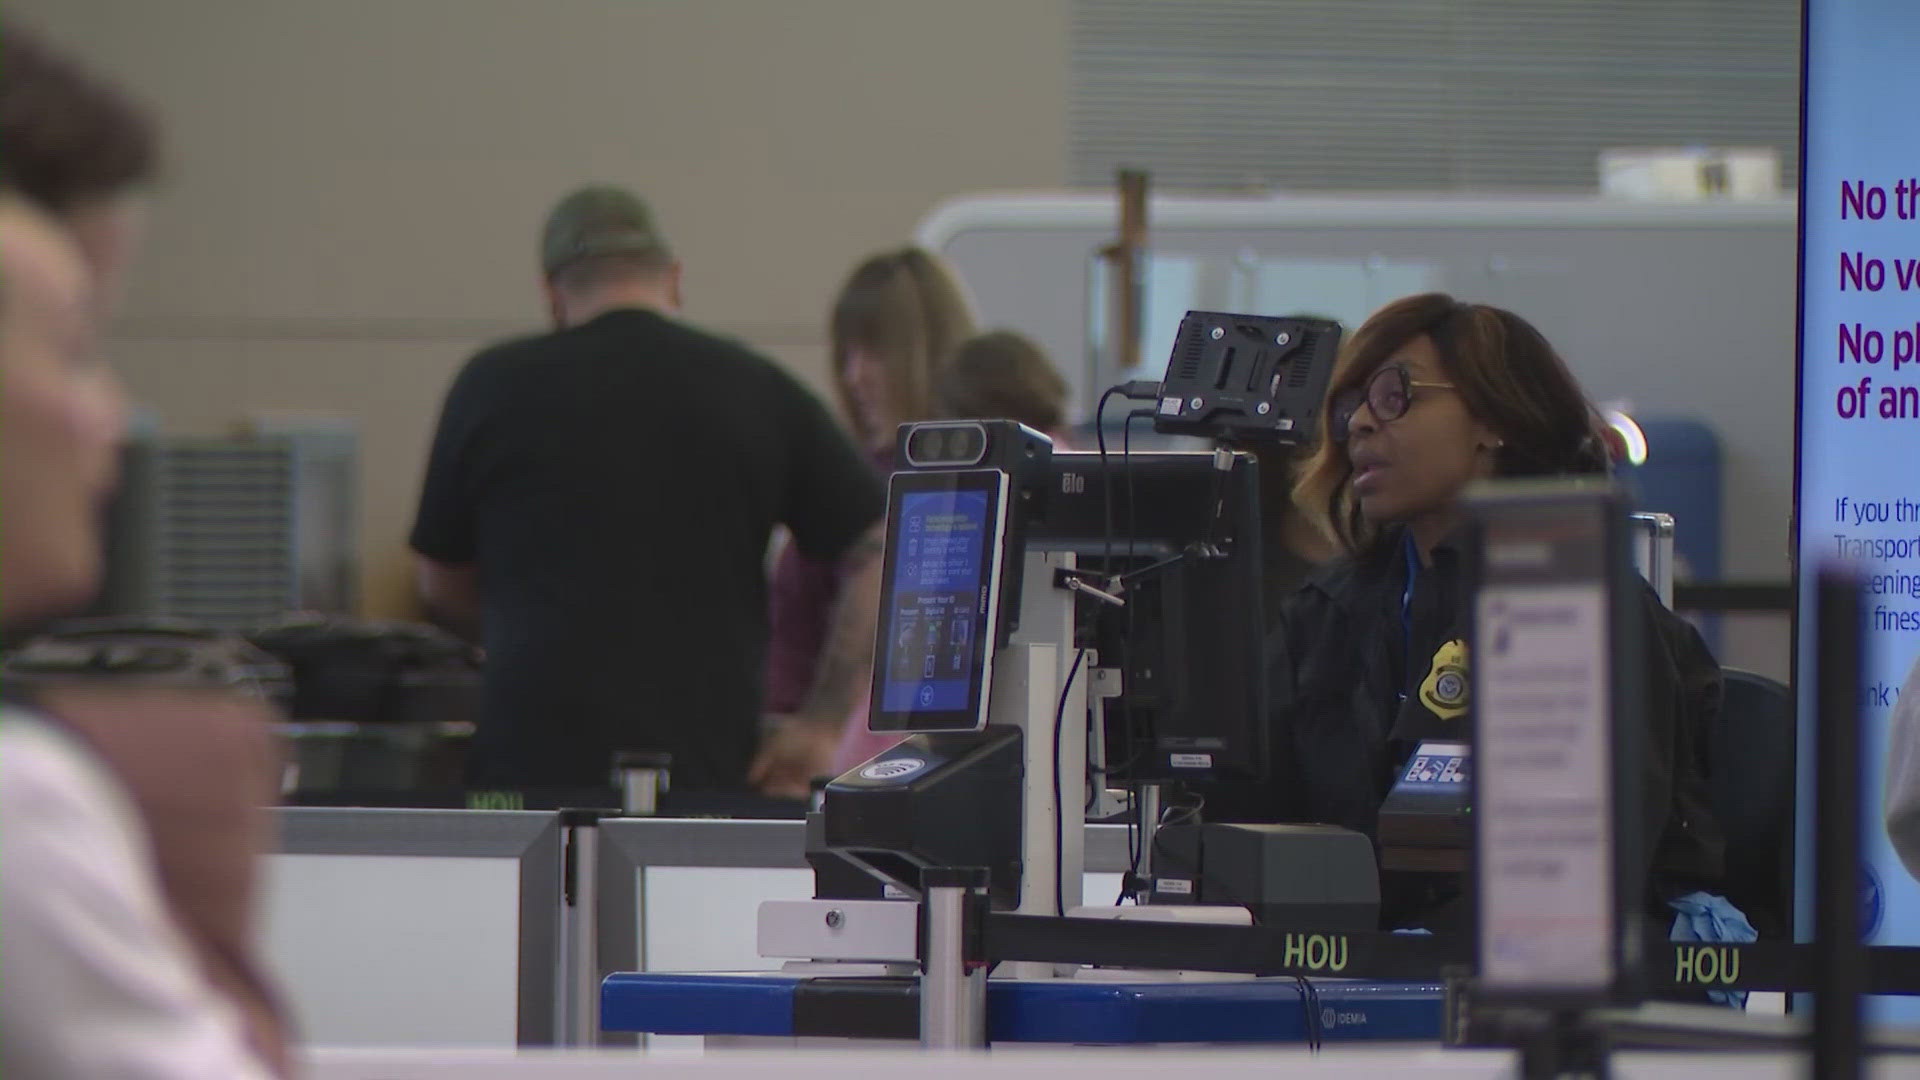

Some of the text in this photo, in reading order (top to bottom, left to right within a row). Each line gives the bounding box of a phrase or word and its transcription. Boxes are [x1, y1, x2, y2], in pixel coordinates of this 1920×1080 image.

[1841, 180, 1886, 220] No
[1840, 251, 1885, 292] No
[1839, 323, 1884, 364] No
[1837, 376, 1919, 419] of an
[1835, 496, 1848, 522] If
[1853, 502, 1889, 526] you
[1873, 604, 1920, 631] fines
[1283, 933, 1348, 971] HOU
[1675, 946, 1740, 984] HOU
[1337, 1013, 1367, 1024] IDEMIA
